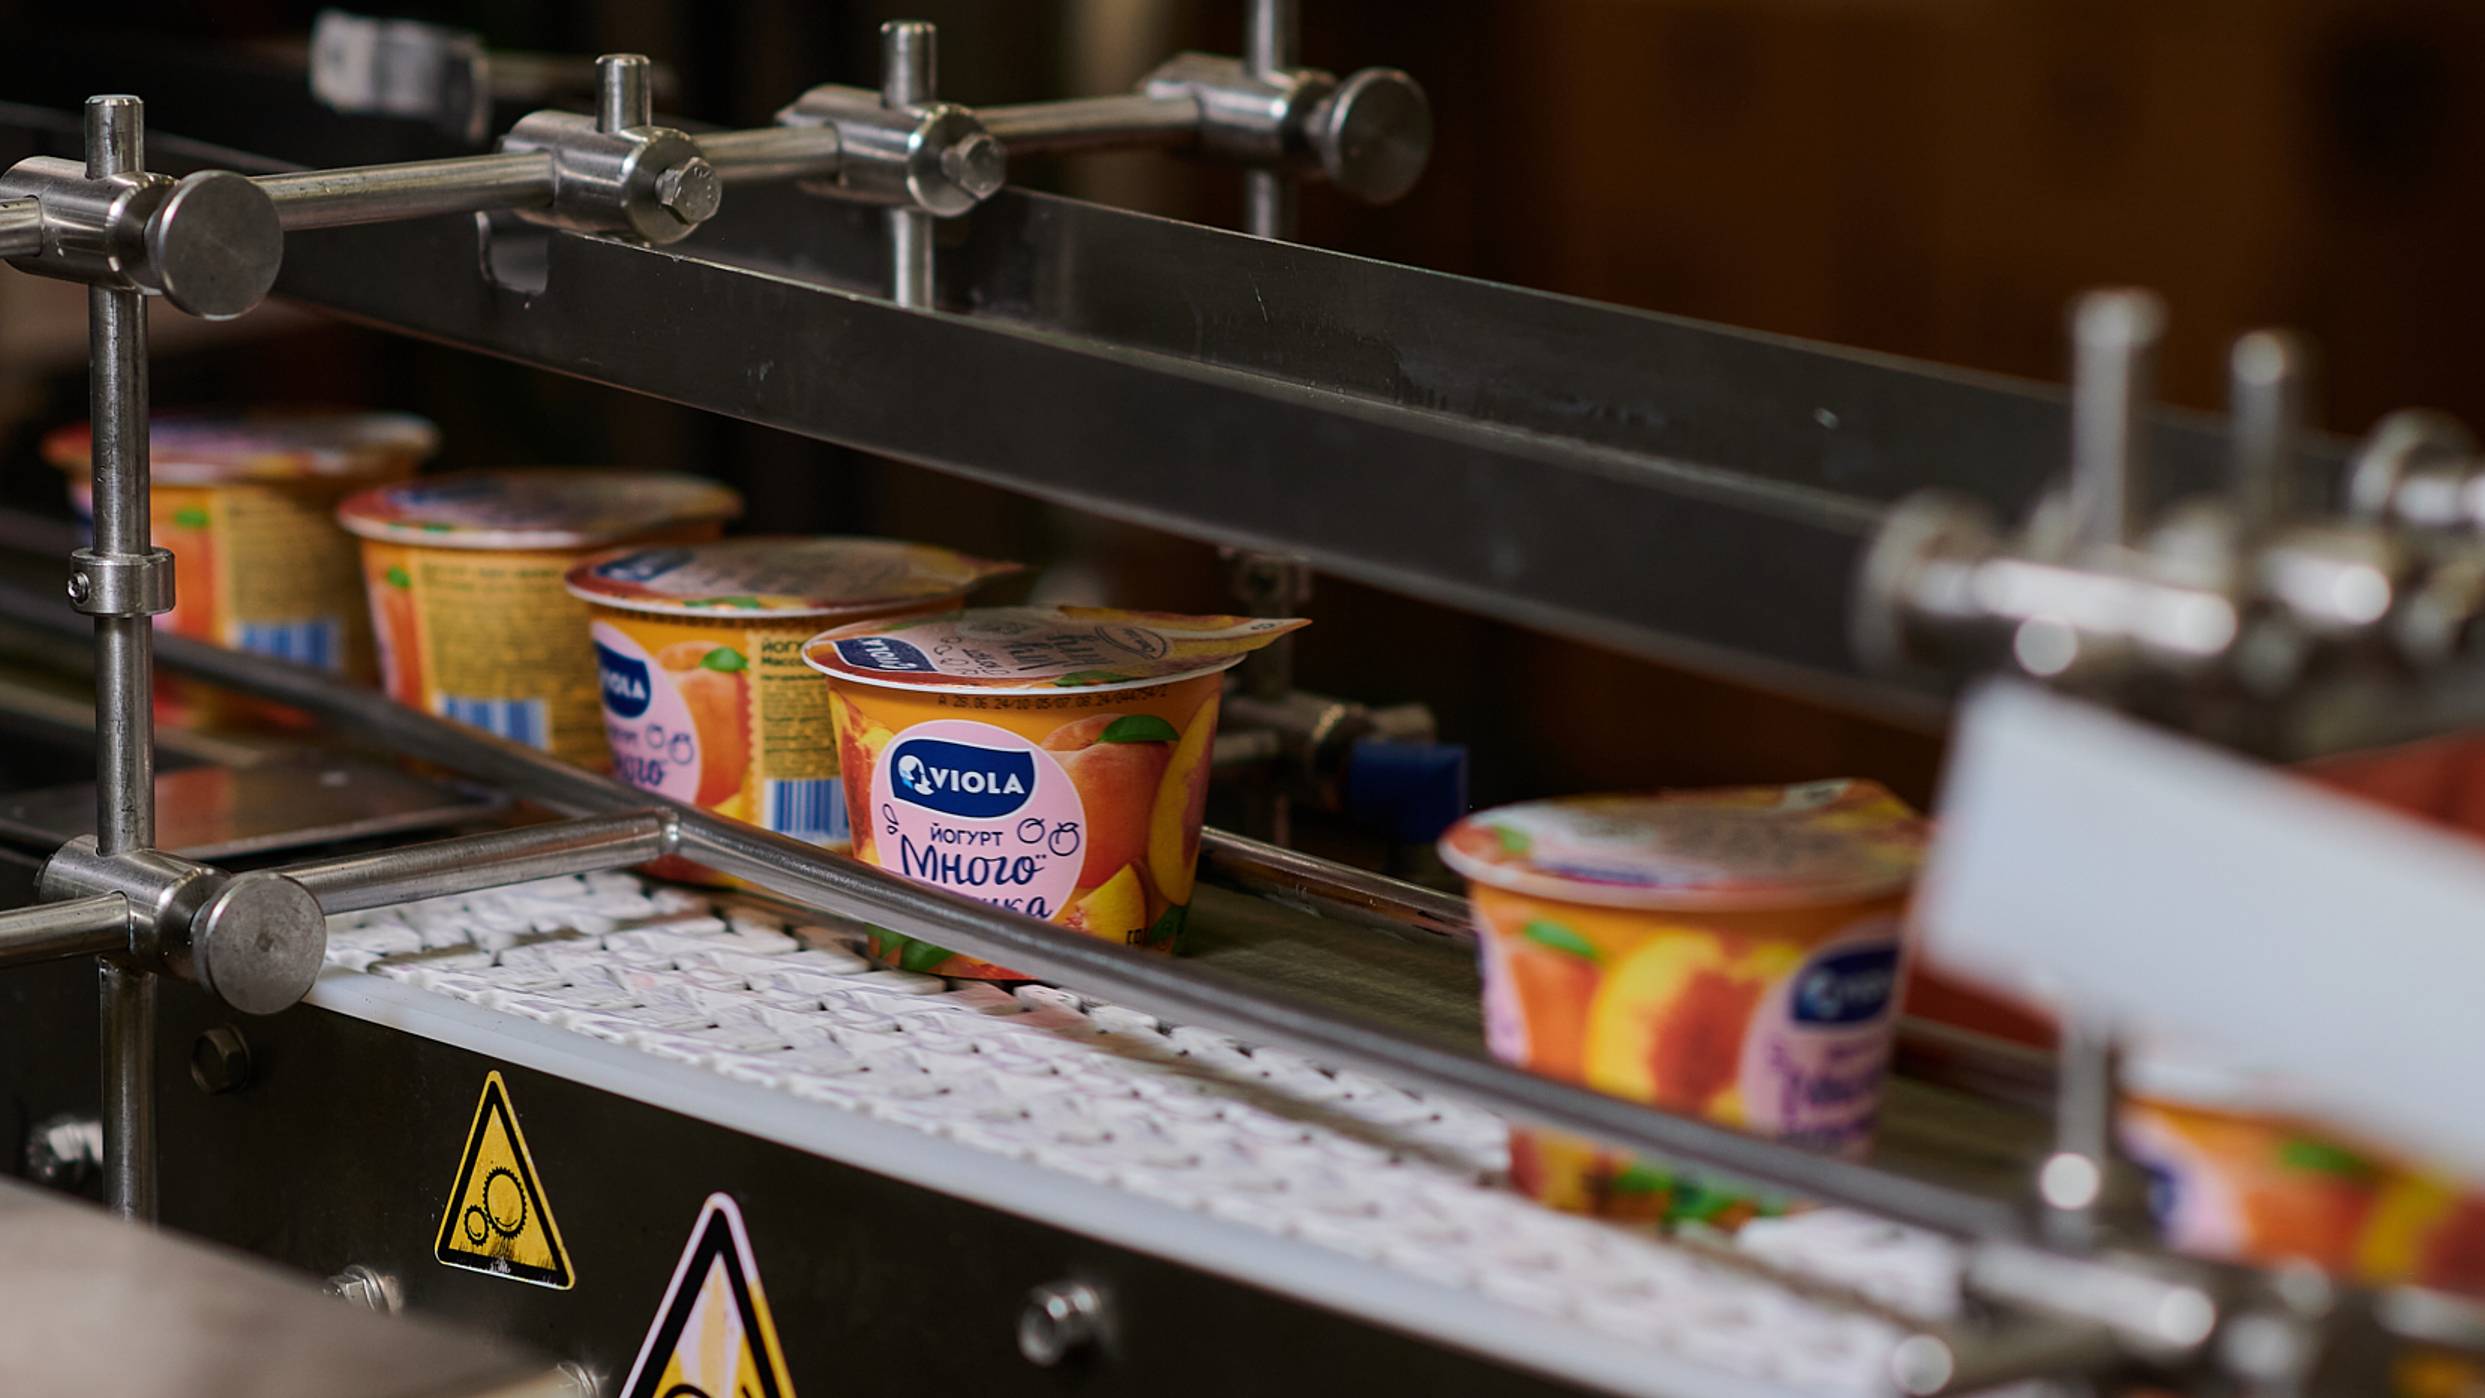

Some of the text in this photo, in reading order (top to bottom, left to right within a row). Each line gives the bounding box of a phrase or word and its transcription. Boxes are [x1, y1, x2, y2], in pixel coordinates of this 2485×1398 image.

[928, 766, 1026, 795] VIOLA
[930, 822, 1004, 847] ЙОГУРТ
[900, 833, 1046, 886] Много
